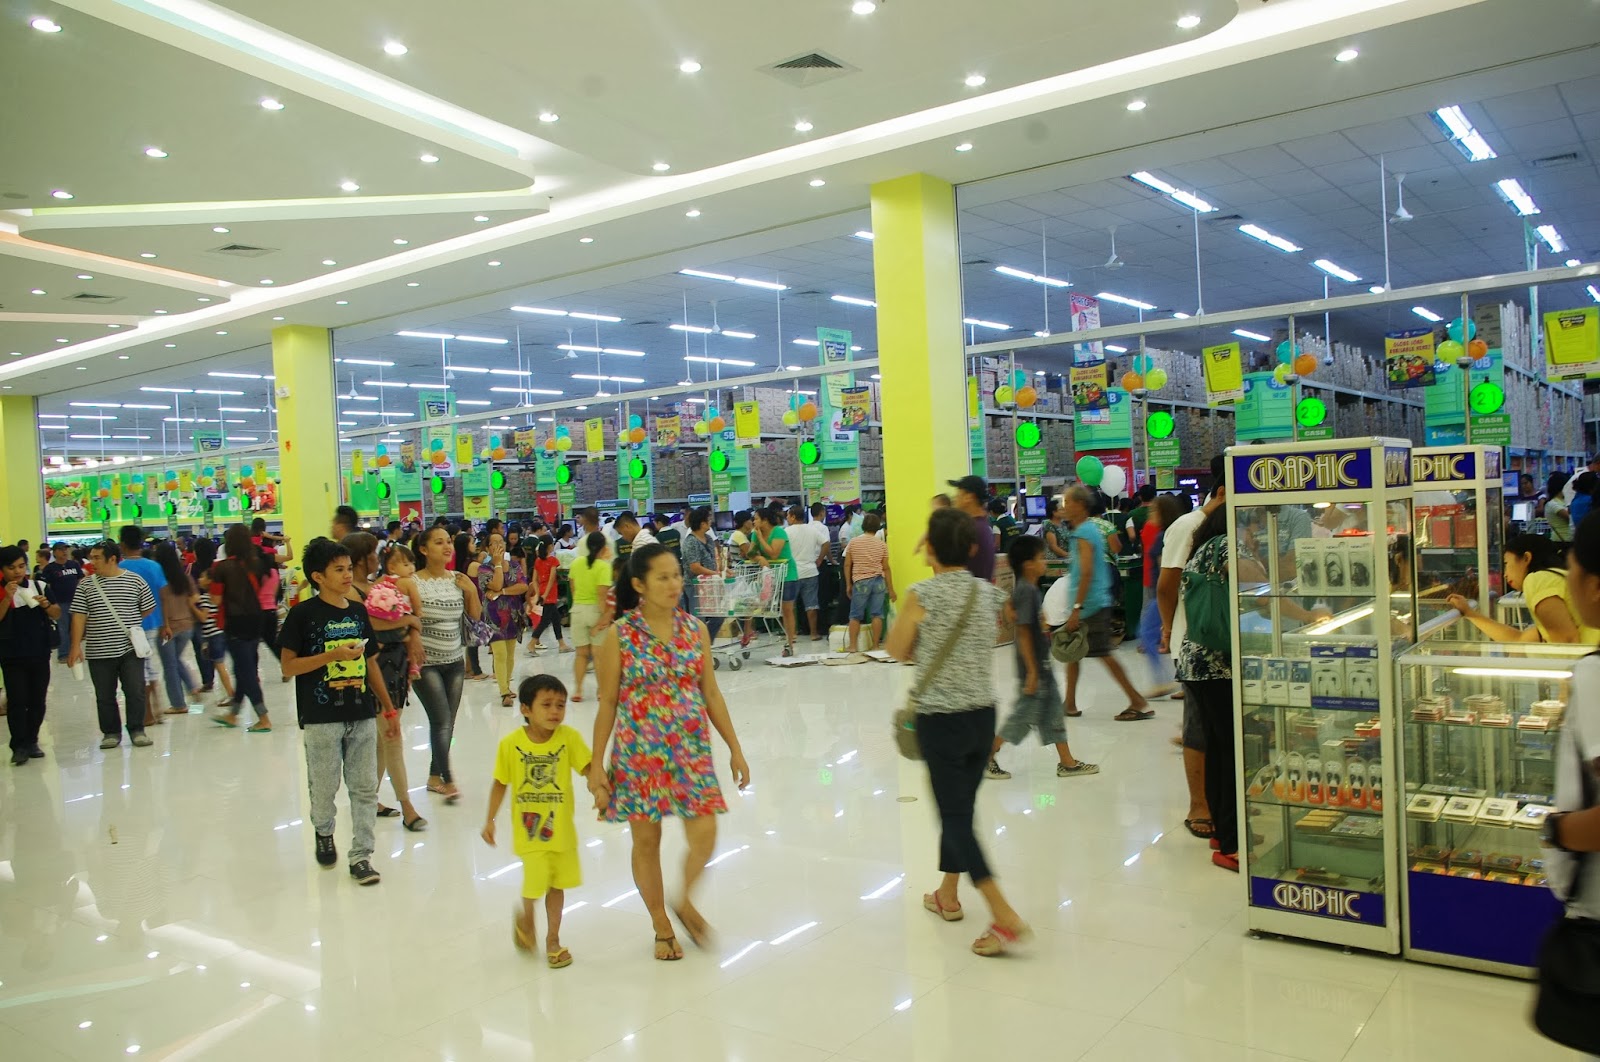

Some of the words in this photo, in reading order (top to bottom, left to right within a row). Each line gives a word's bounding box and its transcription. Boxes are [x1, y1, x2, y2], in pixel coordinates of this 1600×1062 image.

[1477, 391, 1496, 406] 21
[1301, 406, 1320, 419] 20
[1473, 427, 1509, 435] CHARGE
[1248, 453, 1358, 492] GRAPHIC
[1272, 883, 1361, 919] GRAPHIC
